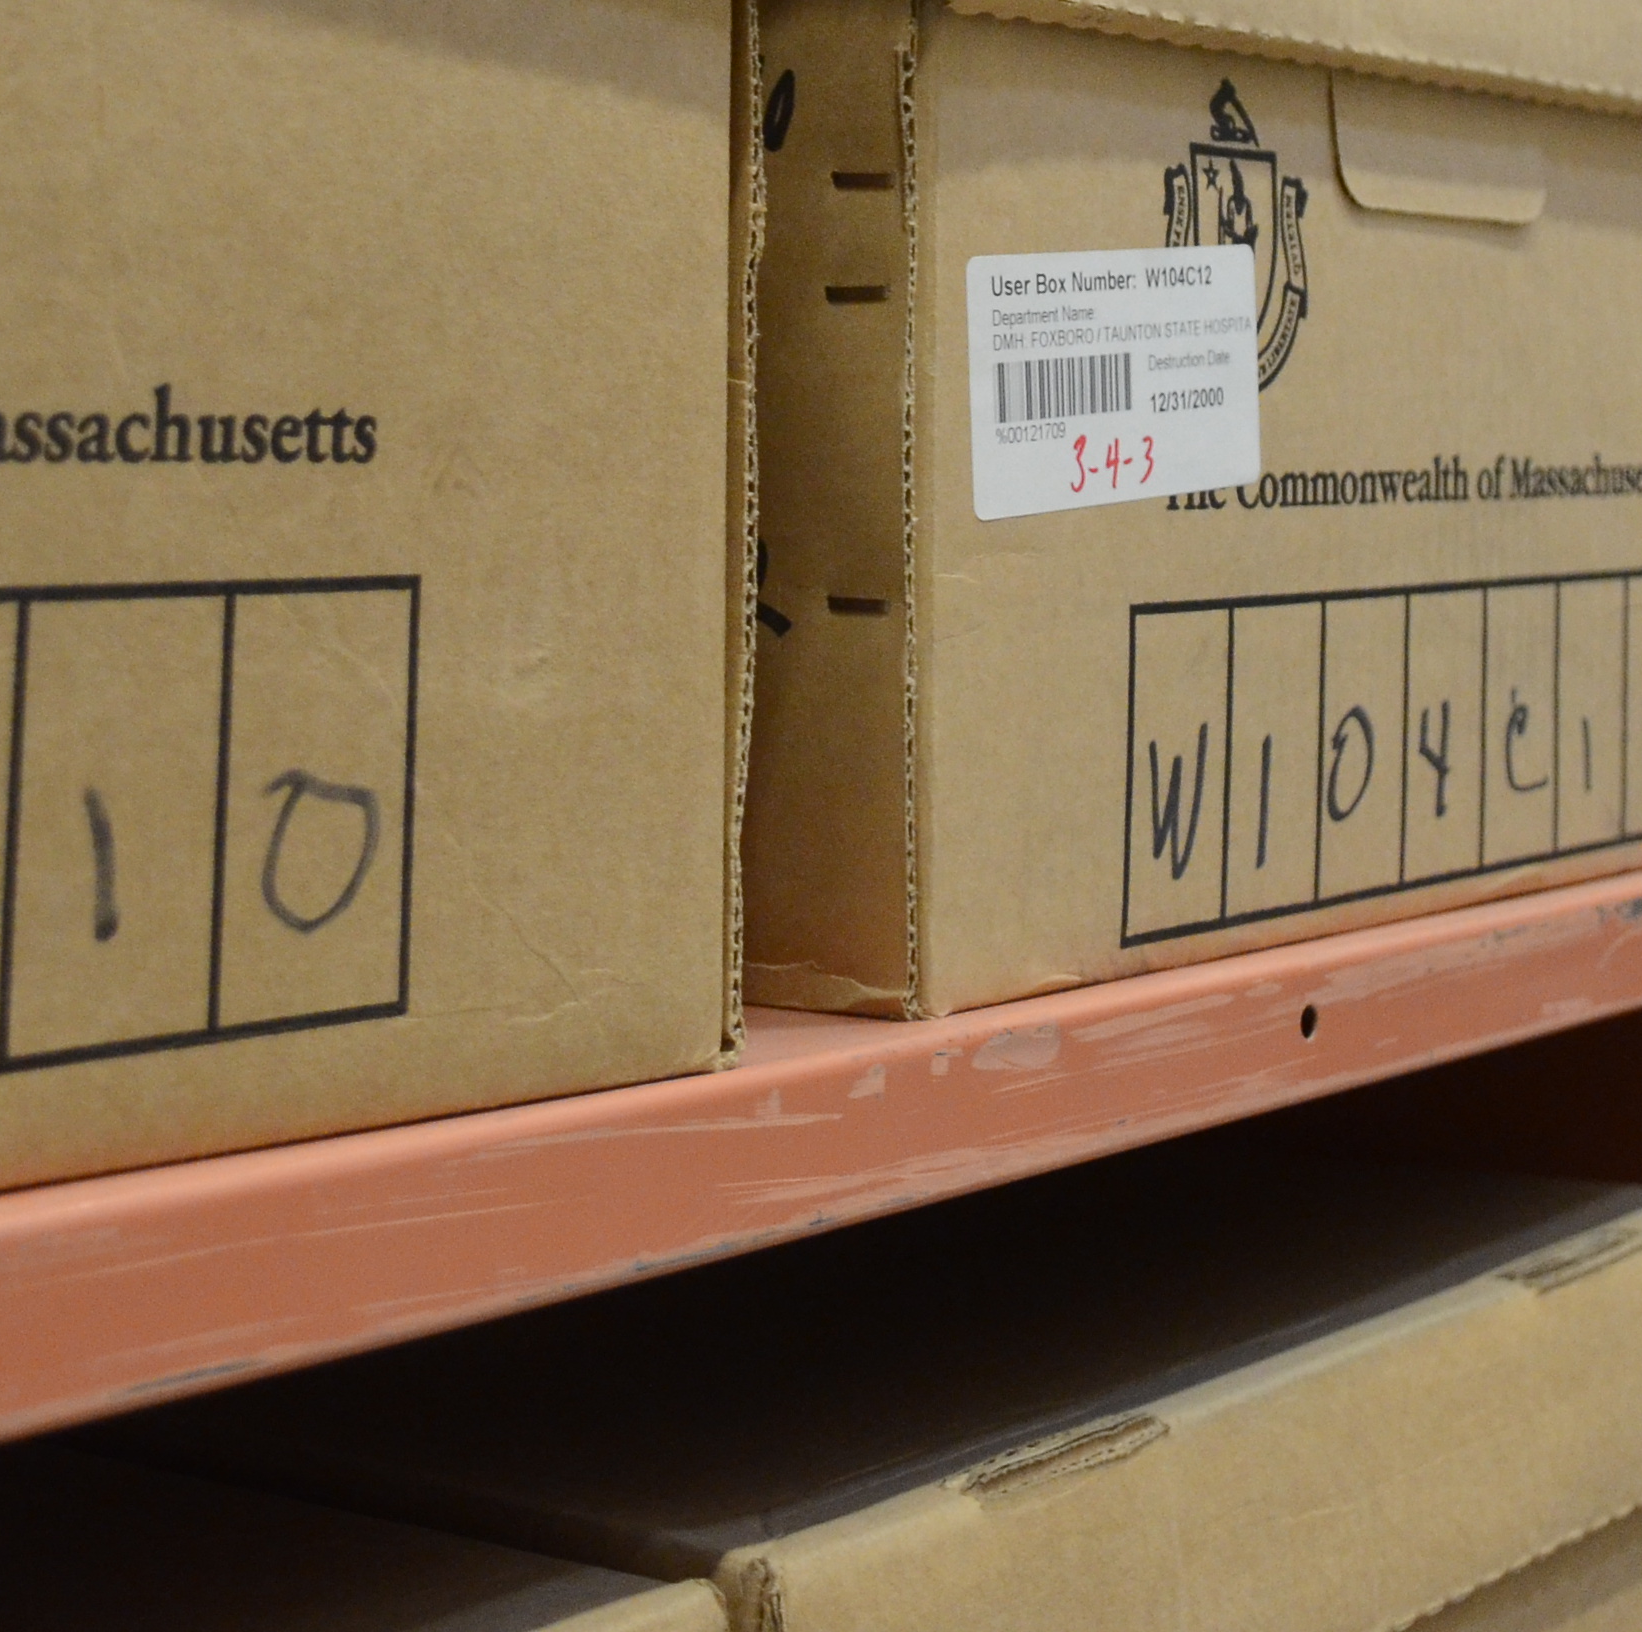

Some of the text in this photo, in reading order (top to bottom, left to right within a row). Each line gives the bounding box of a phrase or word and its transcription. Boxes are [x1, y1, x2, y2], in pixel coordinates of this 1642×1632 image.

[991, 265, 1212, 297] User Box Number: W104C12
[992, 305, 1095, 329] Department Name
[1031, 327, 1095, 348] FOXBORO
[1104, 323, 1162, 343] TAUNTON
[1163, 319, 1201, 339] STATE
[1148, 348, 1231, 372] Destruction Date
[1150, 386, 1225, 414] 12/31/2000
[995, 421, 1067, 445] %00121709
[1071, 433, 1155, 494] 3-4-3
[1476, 455, 1509, 501] of
